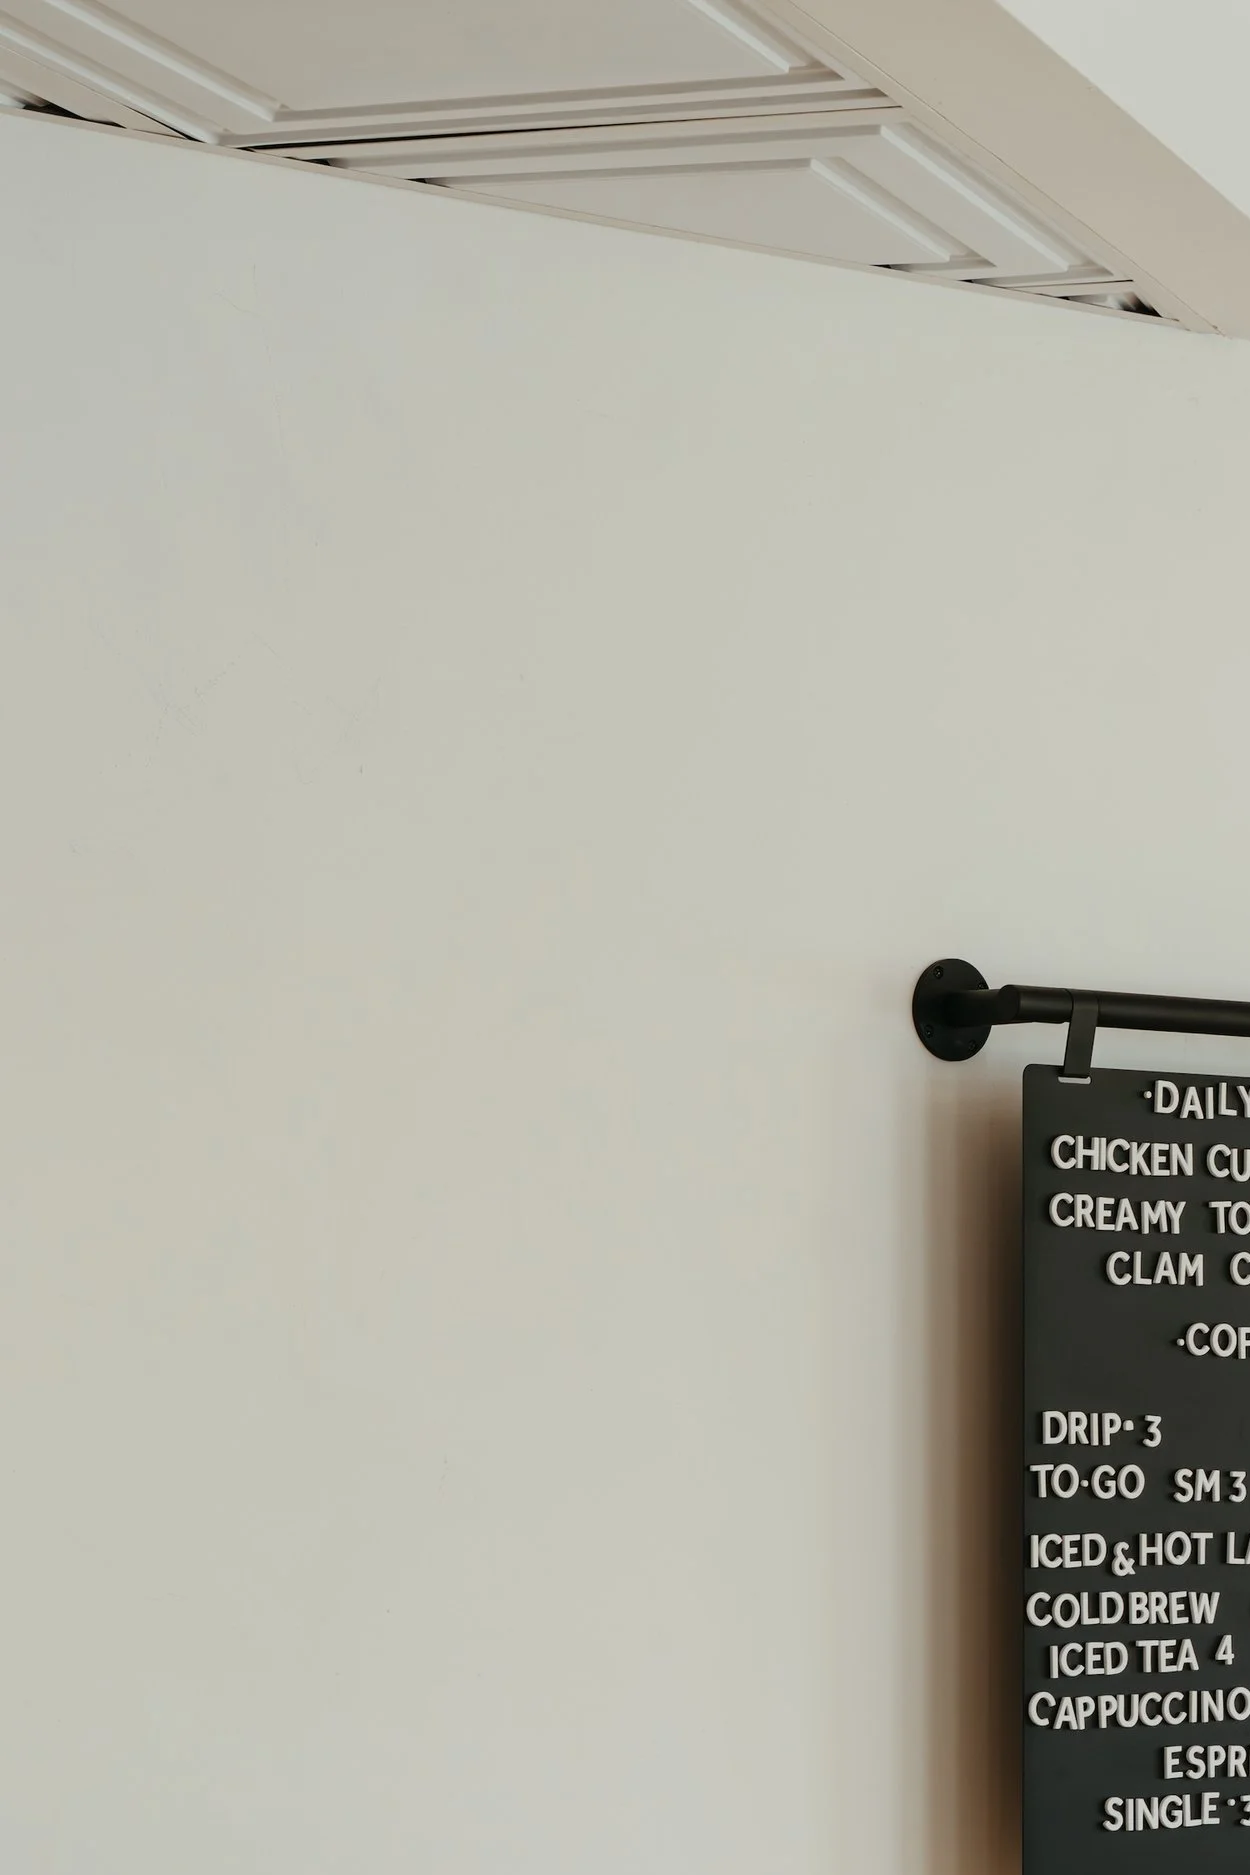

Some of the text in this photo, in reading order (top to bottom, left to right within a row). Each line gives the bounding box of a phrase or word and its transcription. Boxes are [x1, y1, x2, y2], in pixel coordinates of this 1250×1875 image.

[1051, 1134, 1194, 1177] CHICKEN
[1049, 1192, 1187, 1235] CREAMY
[1106, 1250, 1204, 1287] CLAM
[1173, 1468, 1221, 1503] SM
[1229, 1470, 1247, 1503] 3
[1049, 1634, 1235, 1679] ICED TEA 4
